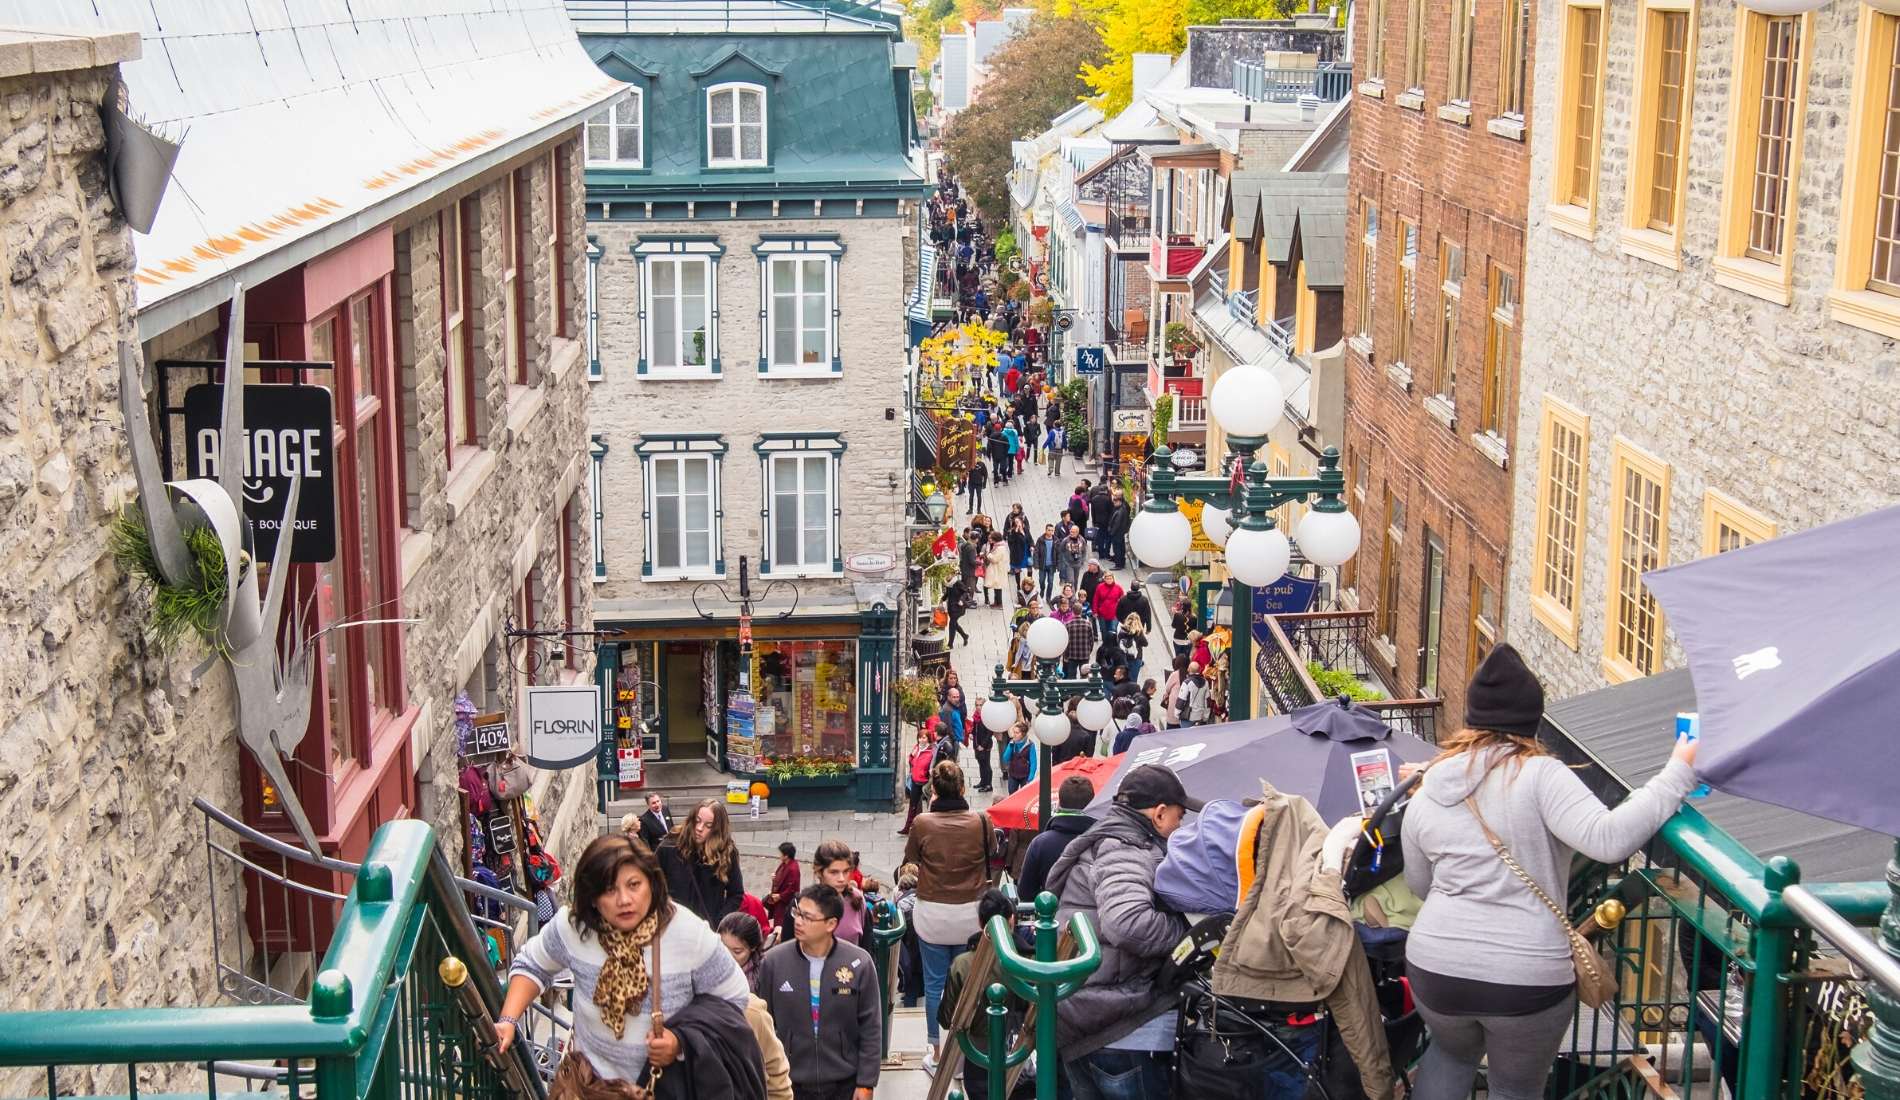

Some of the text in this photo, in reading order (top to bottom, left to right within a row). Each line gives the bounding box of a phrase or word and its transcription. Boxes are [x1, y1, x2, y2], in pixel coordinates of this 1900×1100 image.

[259, 519, 317, 530] BOUQUE
[1273, 583, 1294, 596] pub
[1265, 598, 1283, 610] des
[533, 719, 594, 735] FLORIN
[479, 730, 508, 747] 40%
